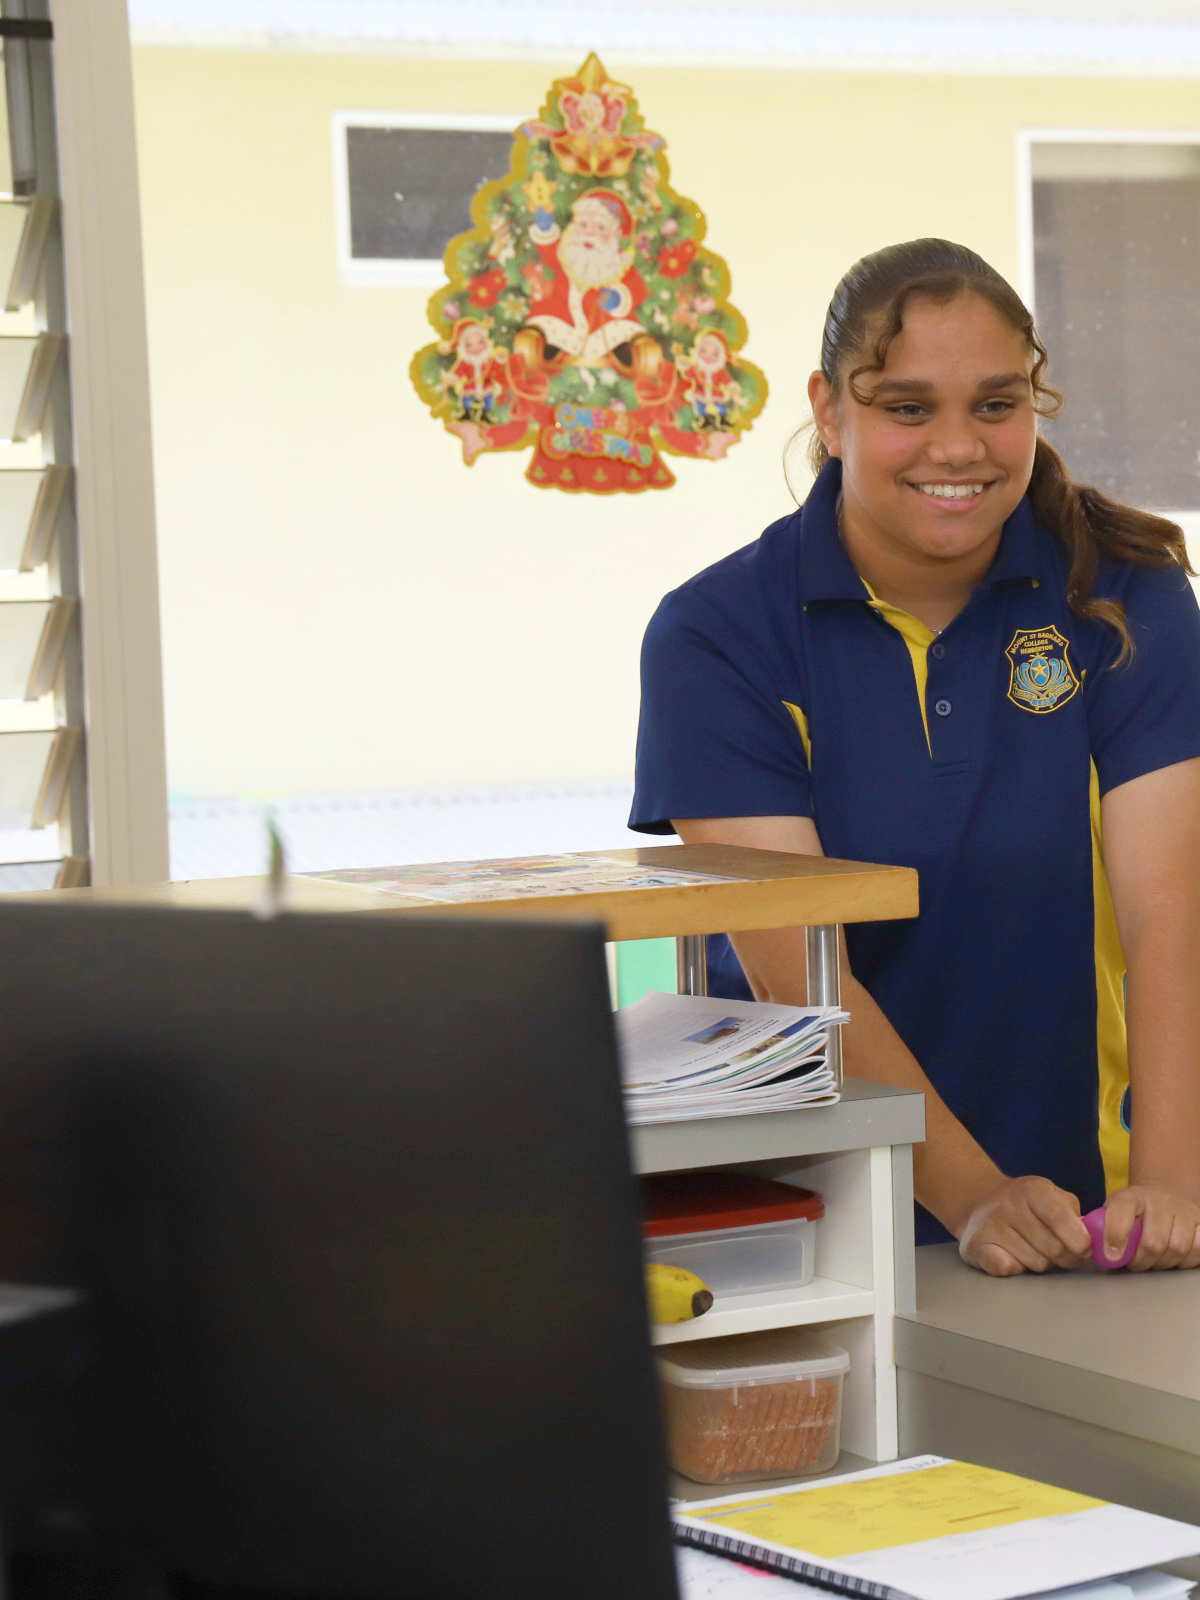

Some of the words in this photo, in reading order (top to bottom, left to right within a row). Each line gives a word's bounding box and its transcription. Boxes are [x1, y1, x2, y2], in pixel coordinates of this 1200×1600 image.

[543, 428, 653, 467] CHRISTMAS
[1010, 635, 1028, 655] MOUNT
[1037, 632, 1064, 647] BERNARD
[1024, 639, 1049, 647] COLLEGE
